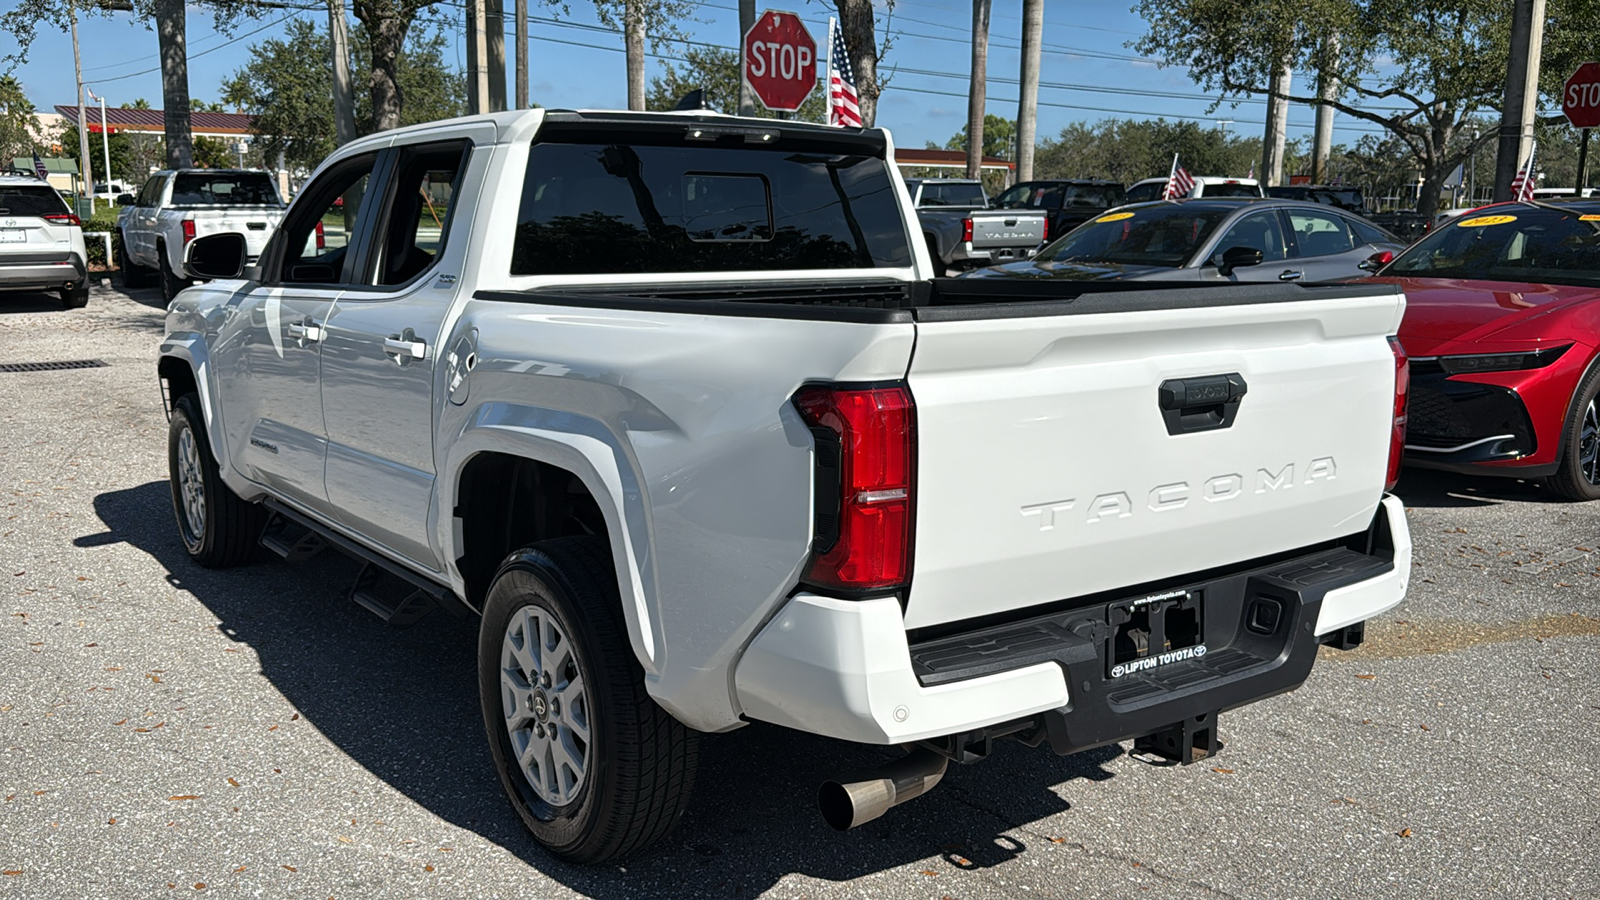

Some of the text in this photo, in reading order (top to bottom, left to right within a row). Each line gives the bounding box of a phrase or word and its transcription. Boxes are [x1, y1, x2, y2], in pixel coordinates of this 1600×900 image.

[751, 40, 812, 80] STOP
[1566, 82, 1600, 109] STO
[1187, 385, 1228, 400] TOYOTA
[1020, 456, 1337, 531] TACOMA
[1125, 648, 1194, 674] LIPTON TOYOTA
